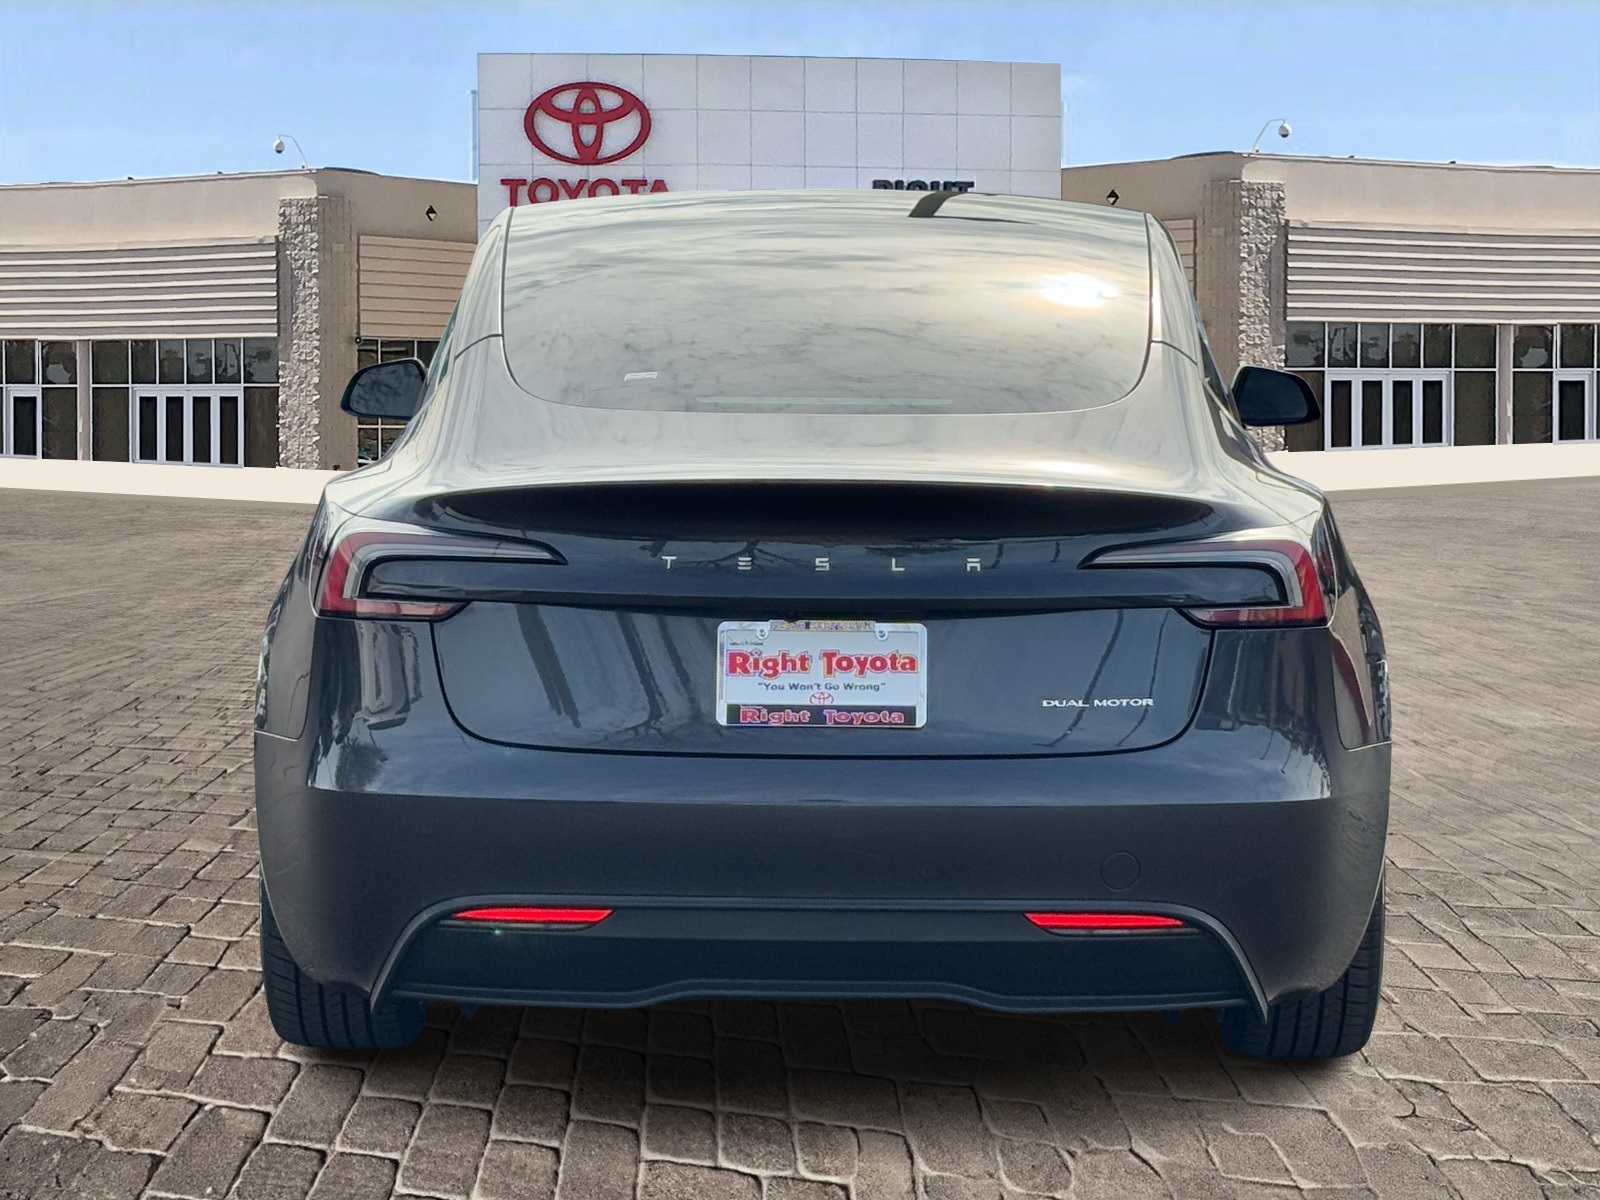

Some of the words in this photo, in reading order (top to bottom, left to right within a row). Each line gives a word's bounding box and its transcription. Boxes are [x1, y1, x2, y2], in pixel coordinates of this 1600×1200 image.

[661, 555, 982, 572] TESLA
[727, 649, 812, 679] Right
[820, 650, 918, 677] Toyota
[789, 682, 821, 691] Won't
[824, 682, 840, 691] Go
[1042, 699, 1090, 708] DUAL
[1093, 698, 1155, 707] MOTOR
[740, 708, 811, 725] Right
[823, 709, 905, 725] Toyota
